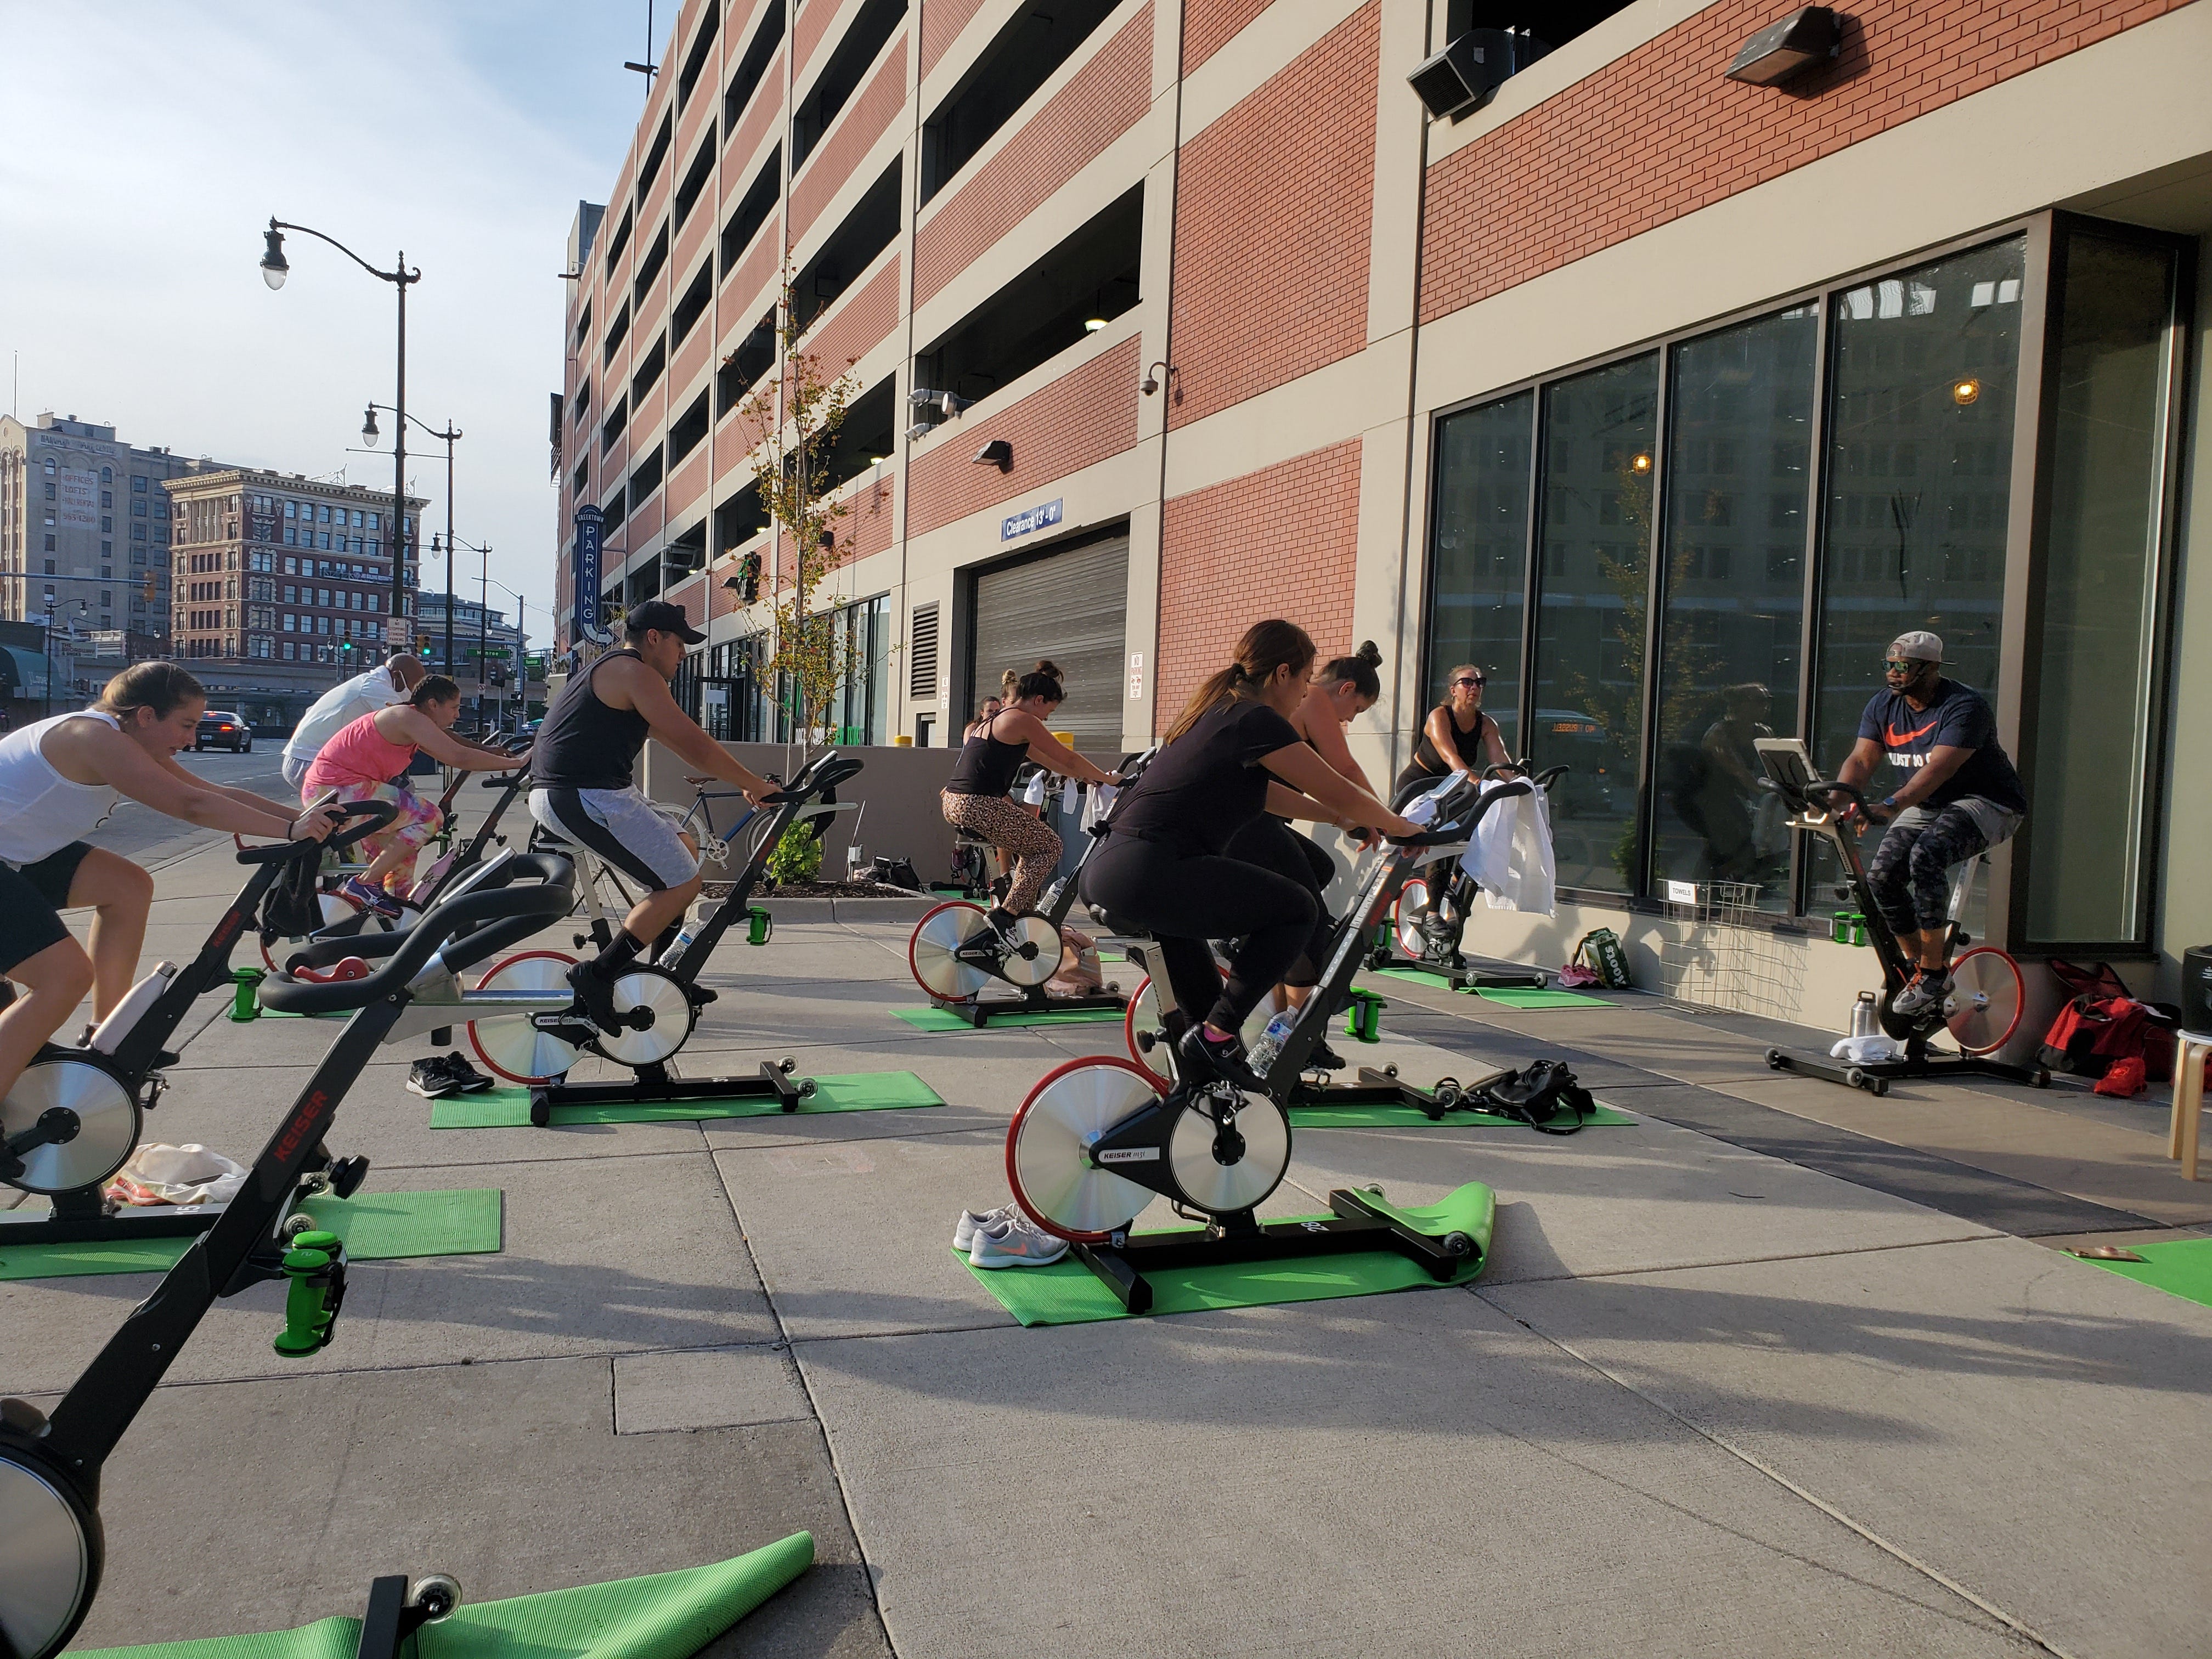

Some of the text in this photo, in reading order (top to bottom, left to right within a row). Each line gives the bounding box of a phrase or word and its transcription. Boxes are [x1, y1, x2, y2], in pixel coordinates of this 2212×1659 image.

[65, 474, 93, 485] OFFICES
[65, 486, 88, 495] LOFTS
[577, 514, 605, 523] GREEKTOWN
[1007, 516, 1035, 536] Clearance
[583, 526, 595, 619] PARKING
[1134, 657, 1139, 666] NO
[1673, 888, 1691, 896] TOWELS
[273, 1090, 328, 1162] KEISER
[174, 1205, 201, 1215] 15
[1300, 1222, 1330, 1232] 28
